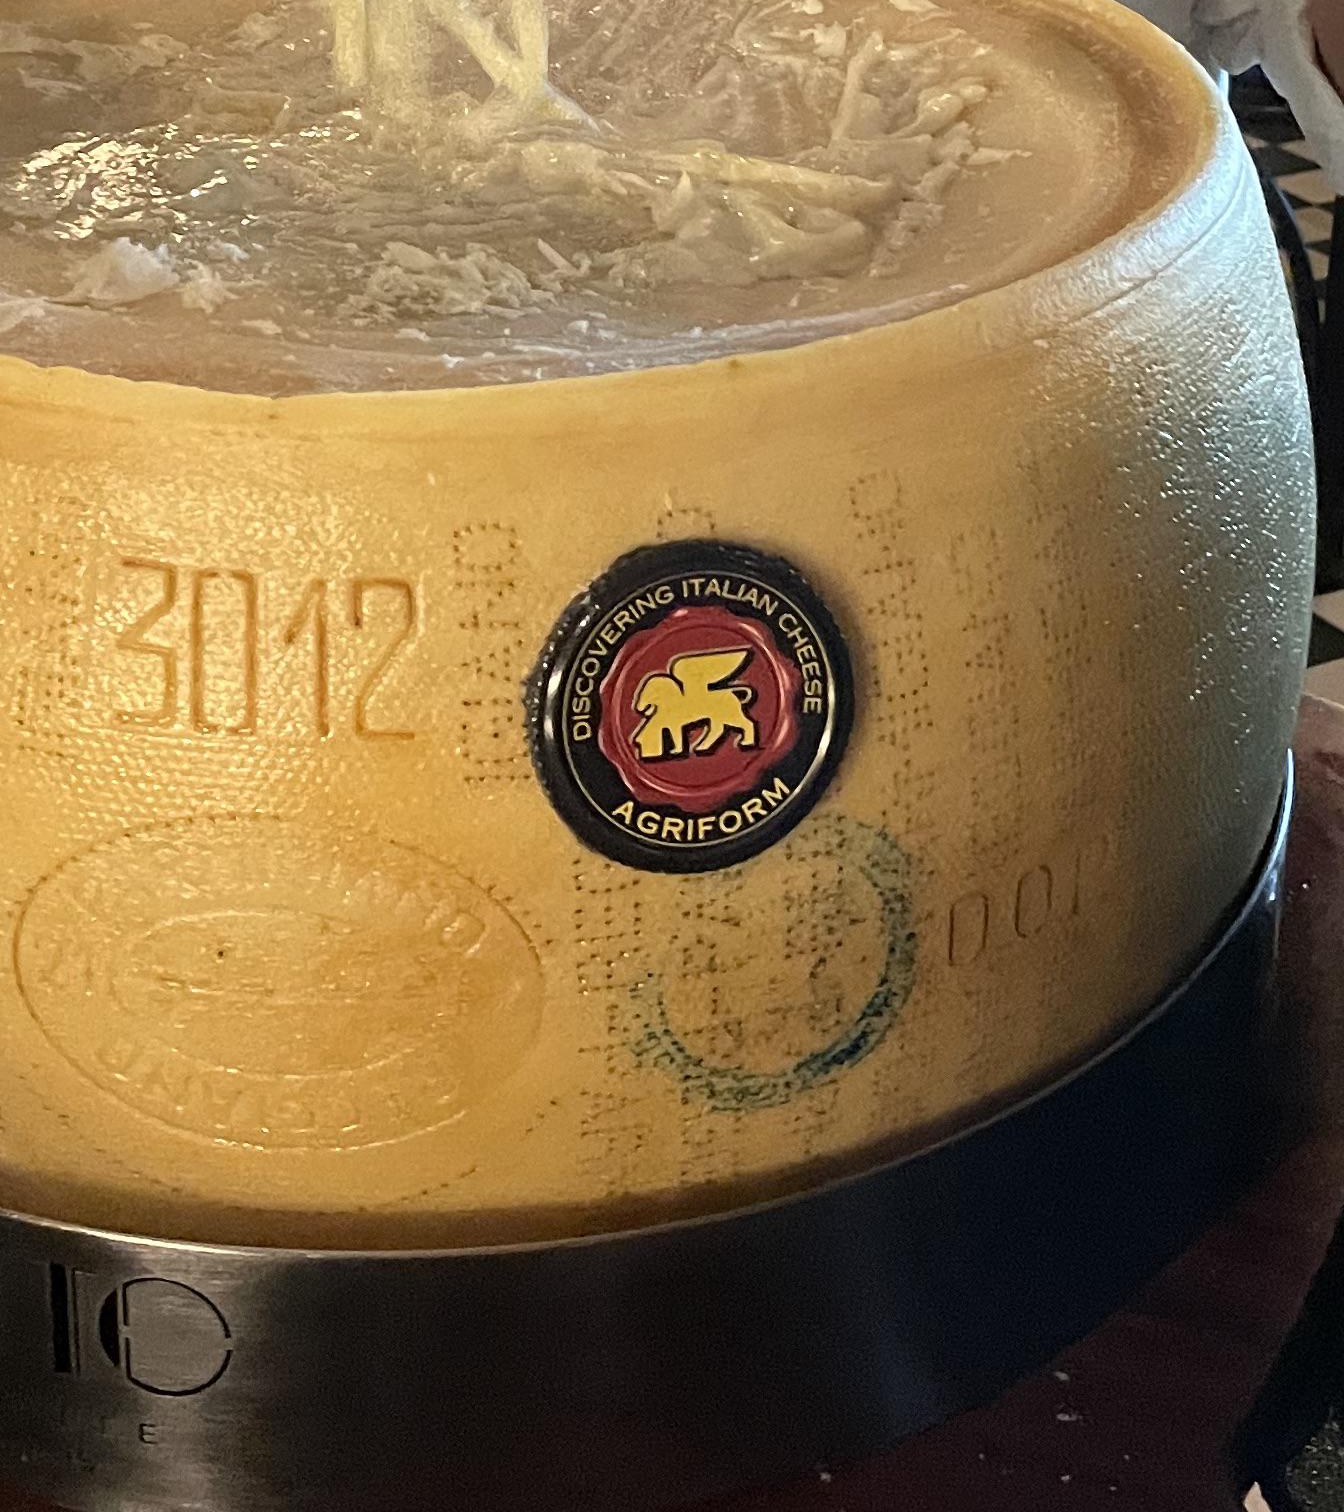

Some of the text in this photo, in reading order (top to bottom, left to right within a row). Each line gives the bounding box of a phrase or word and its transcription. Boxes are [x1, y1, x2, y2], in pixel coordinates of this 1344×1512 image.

[113, 554, 416, 742] 3012
[573, 577, 823, 741] DISCOVERING ITALIAN CHEESE
[612, 777, 791, 841] AGRIFORM
